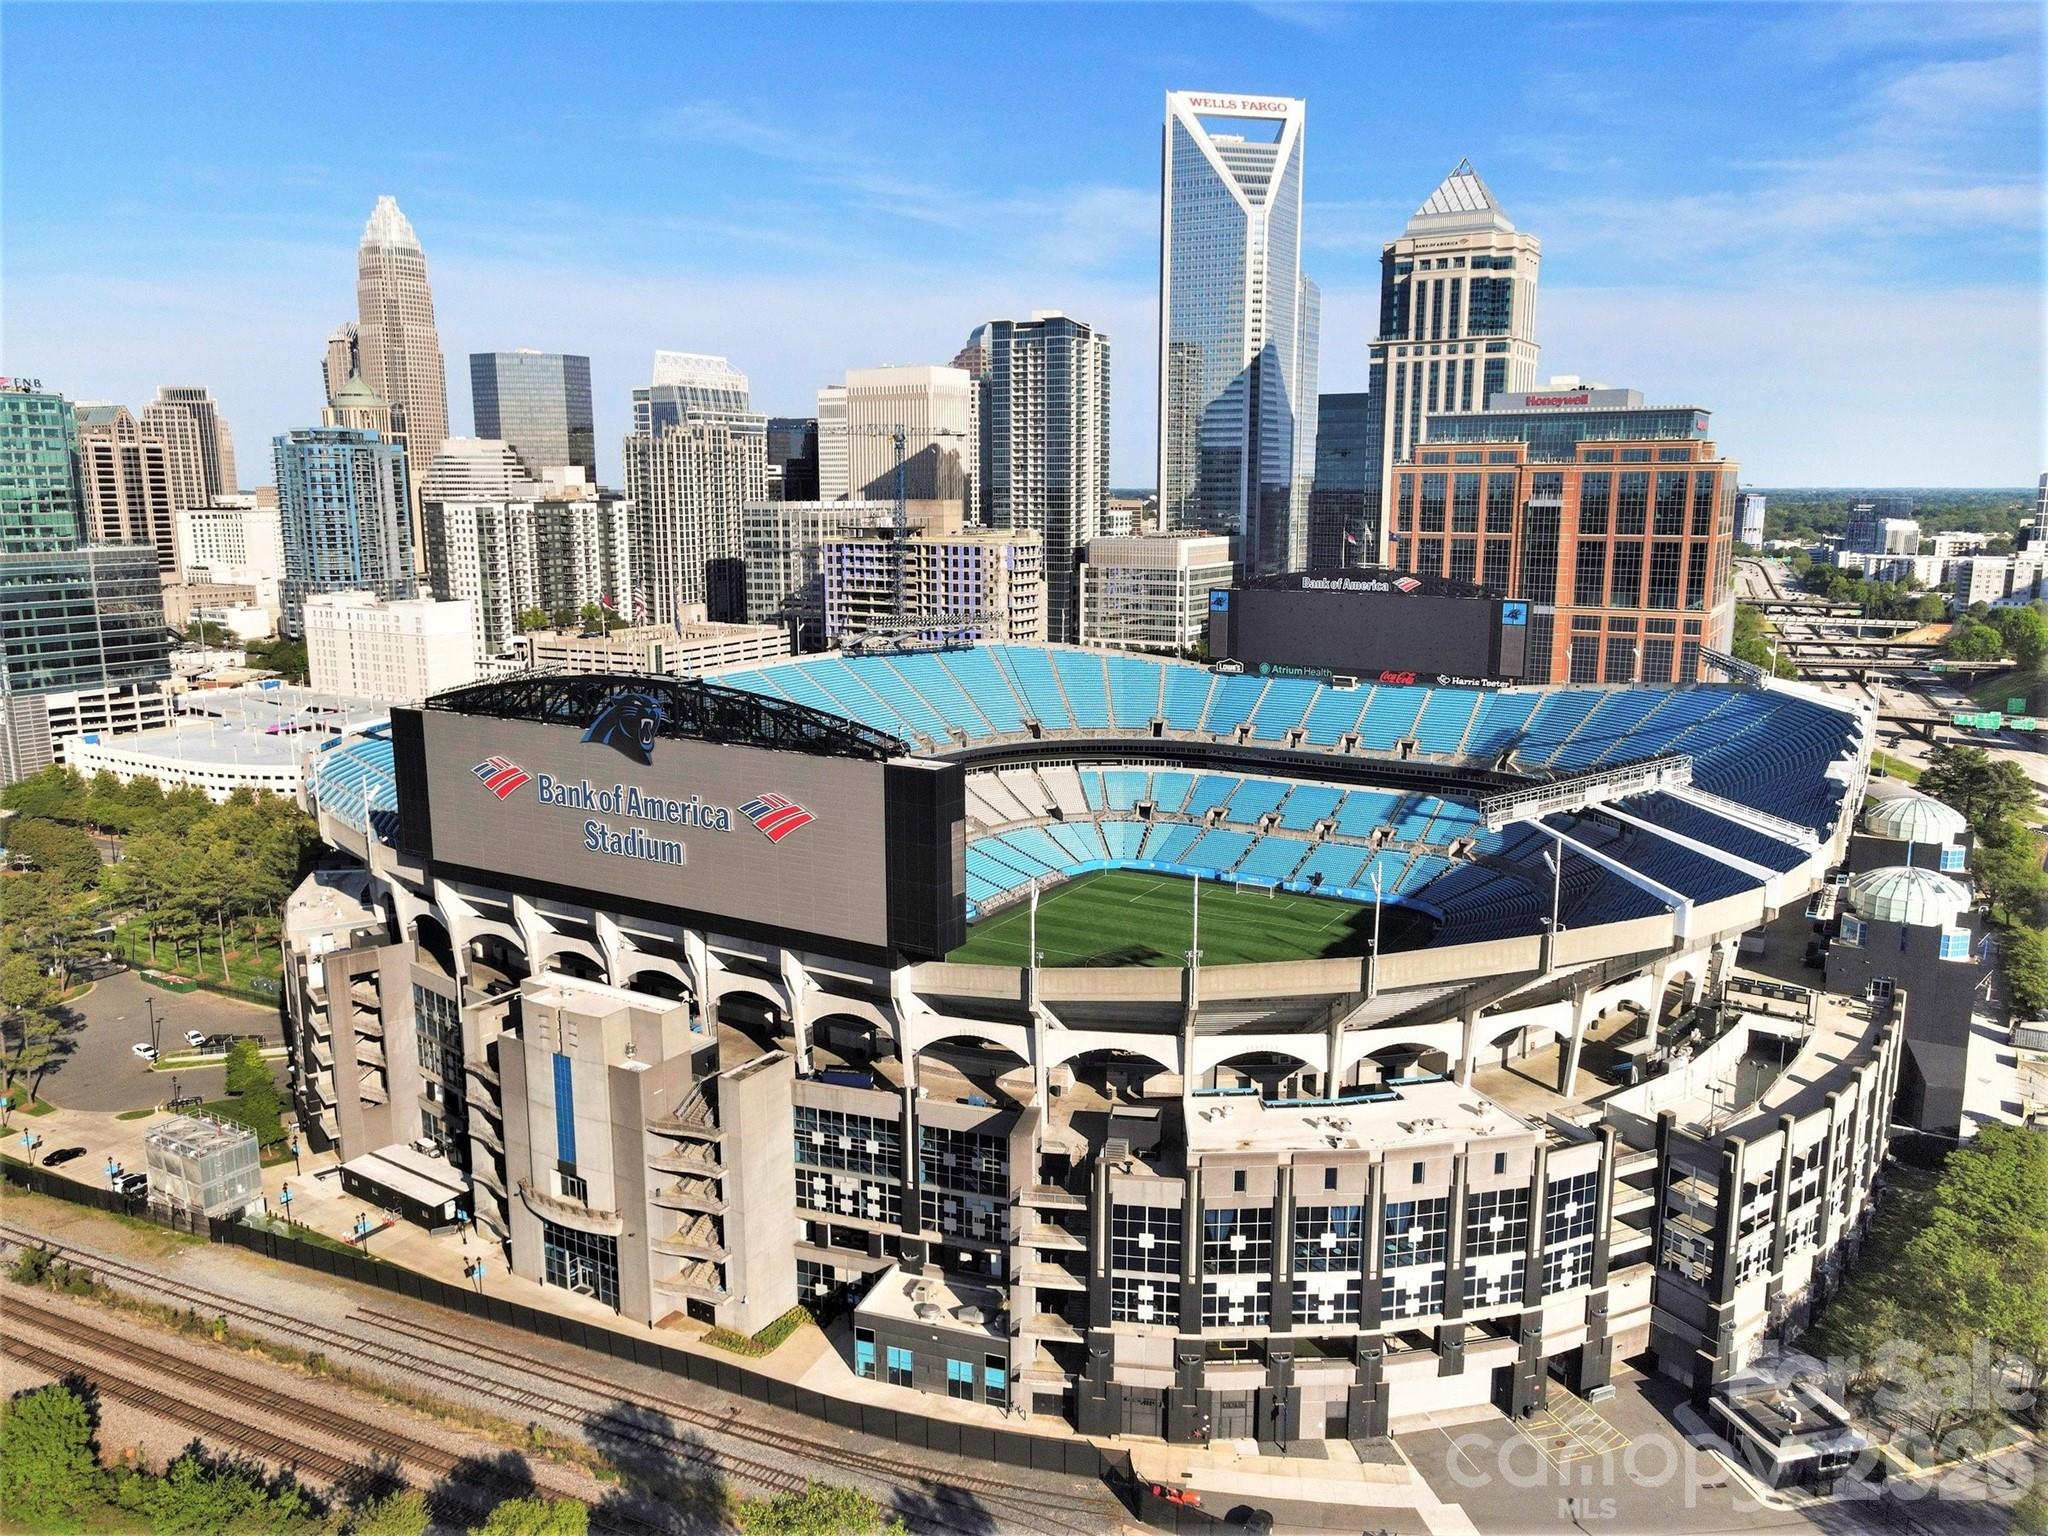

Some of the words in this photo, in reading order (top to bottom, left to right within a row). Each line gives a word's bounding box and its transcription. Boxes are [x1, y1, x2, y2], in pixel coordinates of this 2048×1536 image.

[1188, 97, 1237, 109] WELLS
[1241, 101, 1288, 112] FARGO
[1525, 394, 1589, 408] Honeywell
[1302, 577, 1330, 589] Bank
[1331, 577, 1342, 589] of
[1343, 578, 1389, 592] America
[1271, 664, 1303, 676] Atrium
[1304, 667, 1333, 677] Health
[1452, 677, 1480, 686] Harris
[1481, 679, 1510, 688] Teeter
[537, 773, 598, 811] Bank
[598, 784, 624, 815] of
[625, 786, 734, 833] America
[583, 820, 686, 866] Stadium
